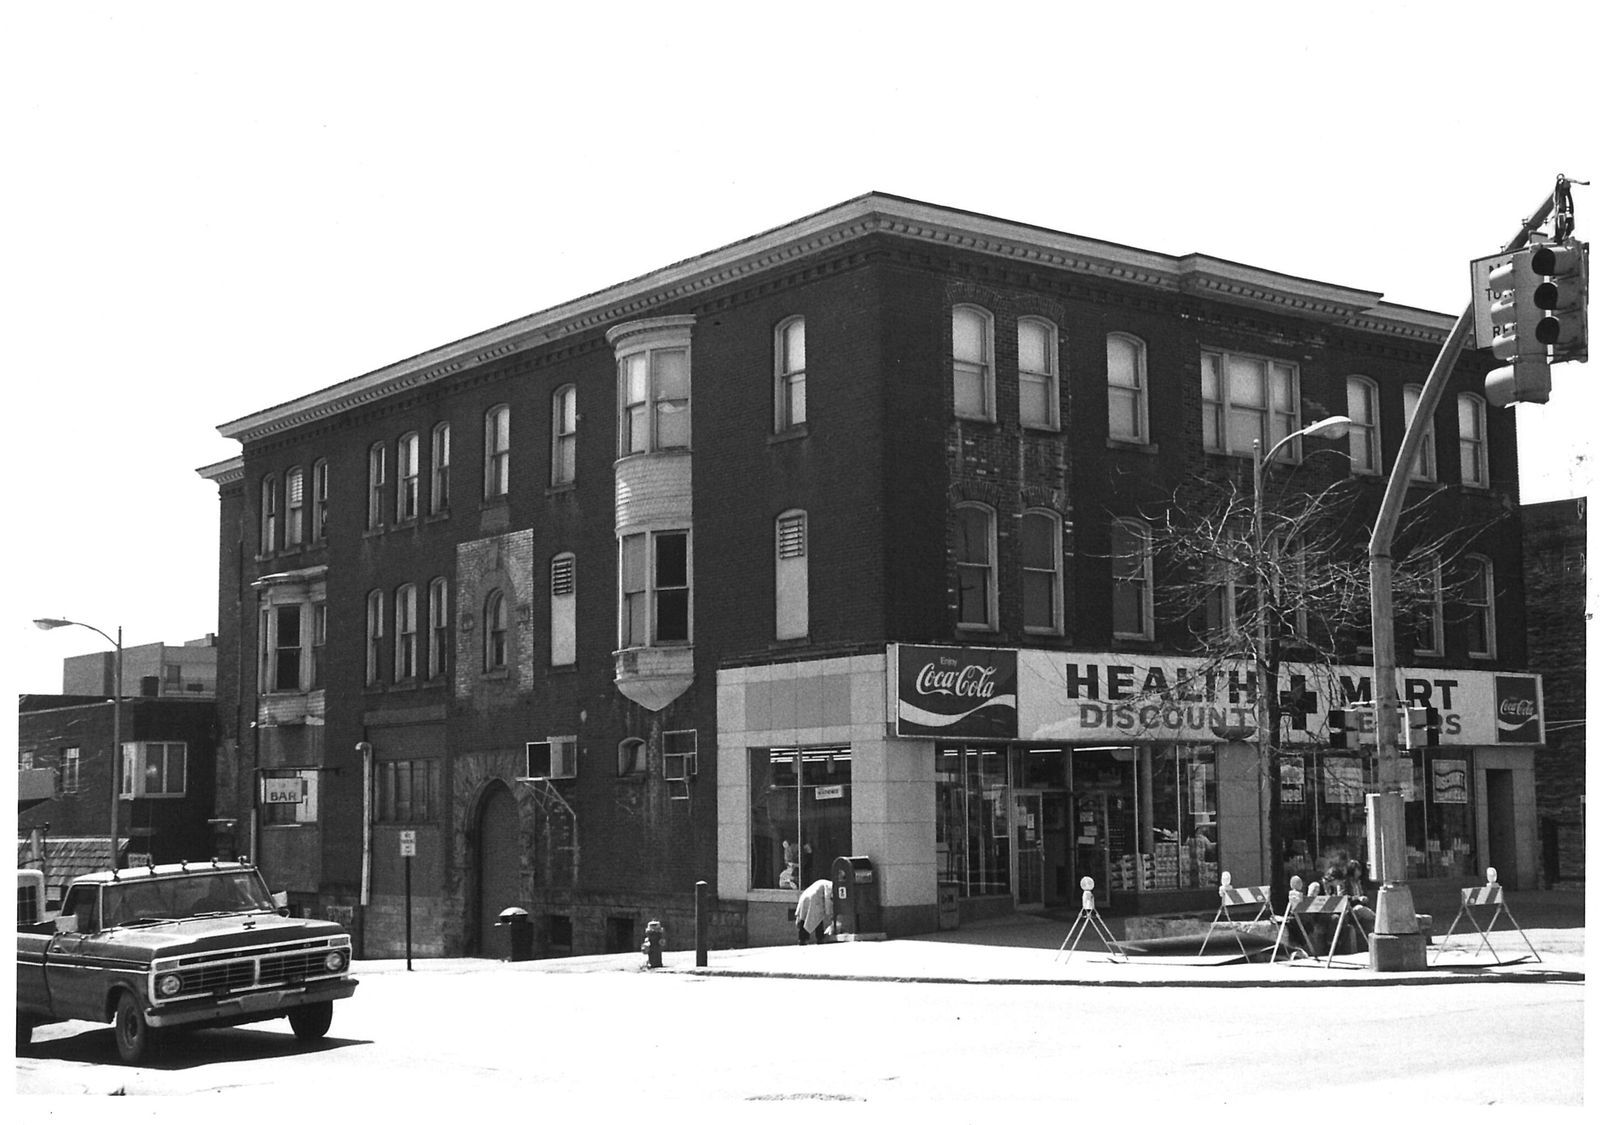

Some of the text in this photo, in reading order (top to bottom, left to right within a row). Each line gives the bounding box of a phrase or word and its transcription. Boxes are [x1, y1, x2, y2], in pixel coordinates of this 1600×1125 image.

[940, 656, 957, 667] Enjoy
[915, 662, 997, 698] Coca-Cola
[1066, 663, 1458, 710] HEALTH MRT
[1080, 703, 1253, 731] DISCOUNT
[1500, 698, 1534, 716] Coca-Cola
[270, 791, 297, 802] BAR
